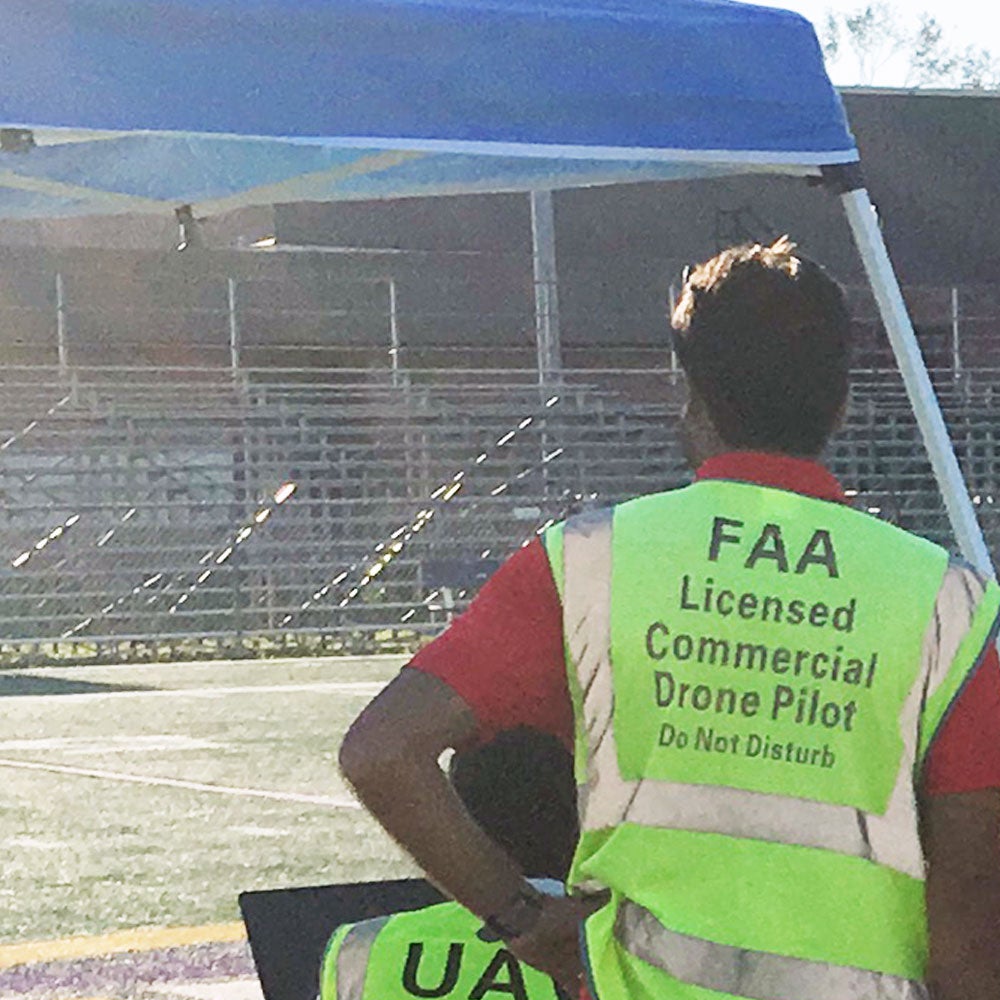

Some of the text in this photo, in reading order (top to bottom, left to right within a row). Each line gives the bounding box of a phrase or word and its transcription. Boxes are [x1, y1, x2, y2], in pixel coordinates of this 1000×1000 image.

[707, 516, 839, 578] FAA
[680, 574, 856, 633] Licensed
[645, 621, 878, 688] Commercial
[654, 671, 857, 732] Drone Pilot
[658, 723, 836, 769] Do Not Disturb
